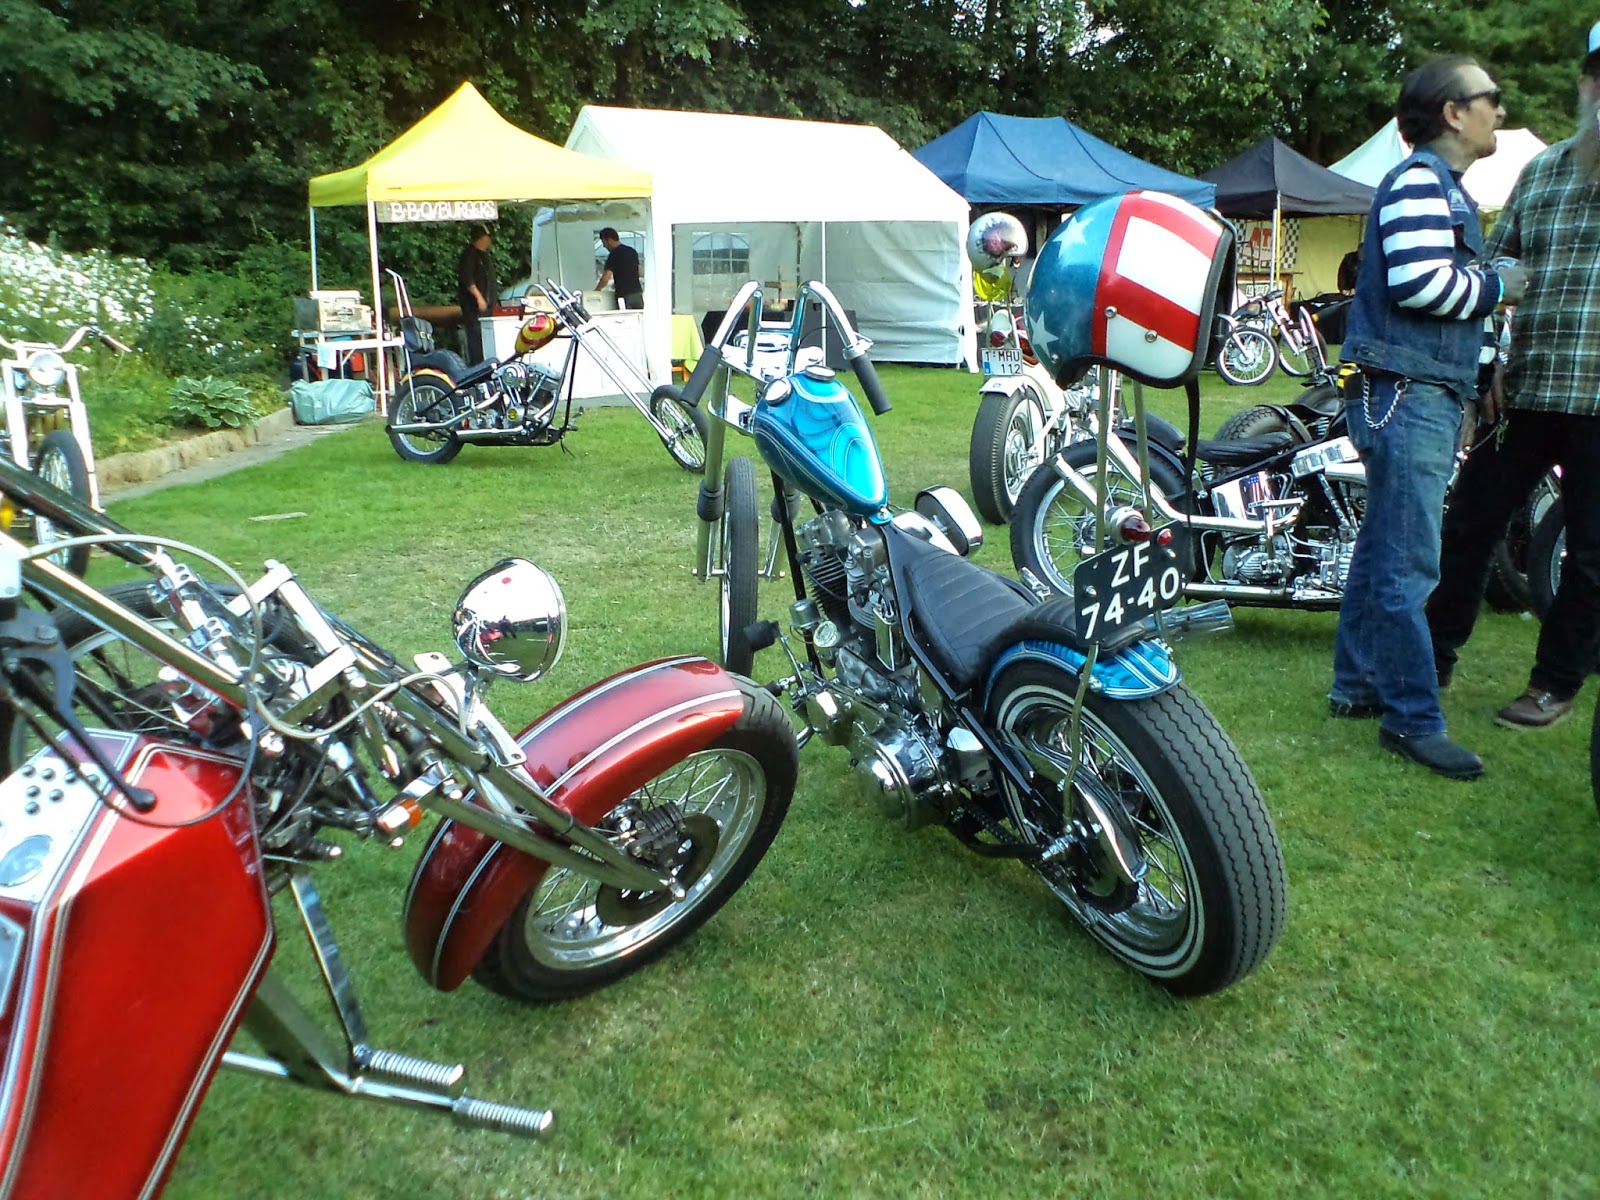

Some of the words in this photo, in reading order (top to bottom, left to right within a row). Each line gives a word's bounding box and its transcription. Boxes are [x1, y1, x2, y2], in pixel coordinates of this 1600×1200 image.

[1001, 363, 1021, 374] 112
[1111, 541, 1151, 588] ZF
[1081, 567, 1179, 640] 74-40
